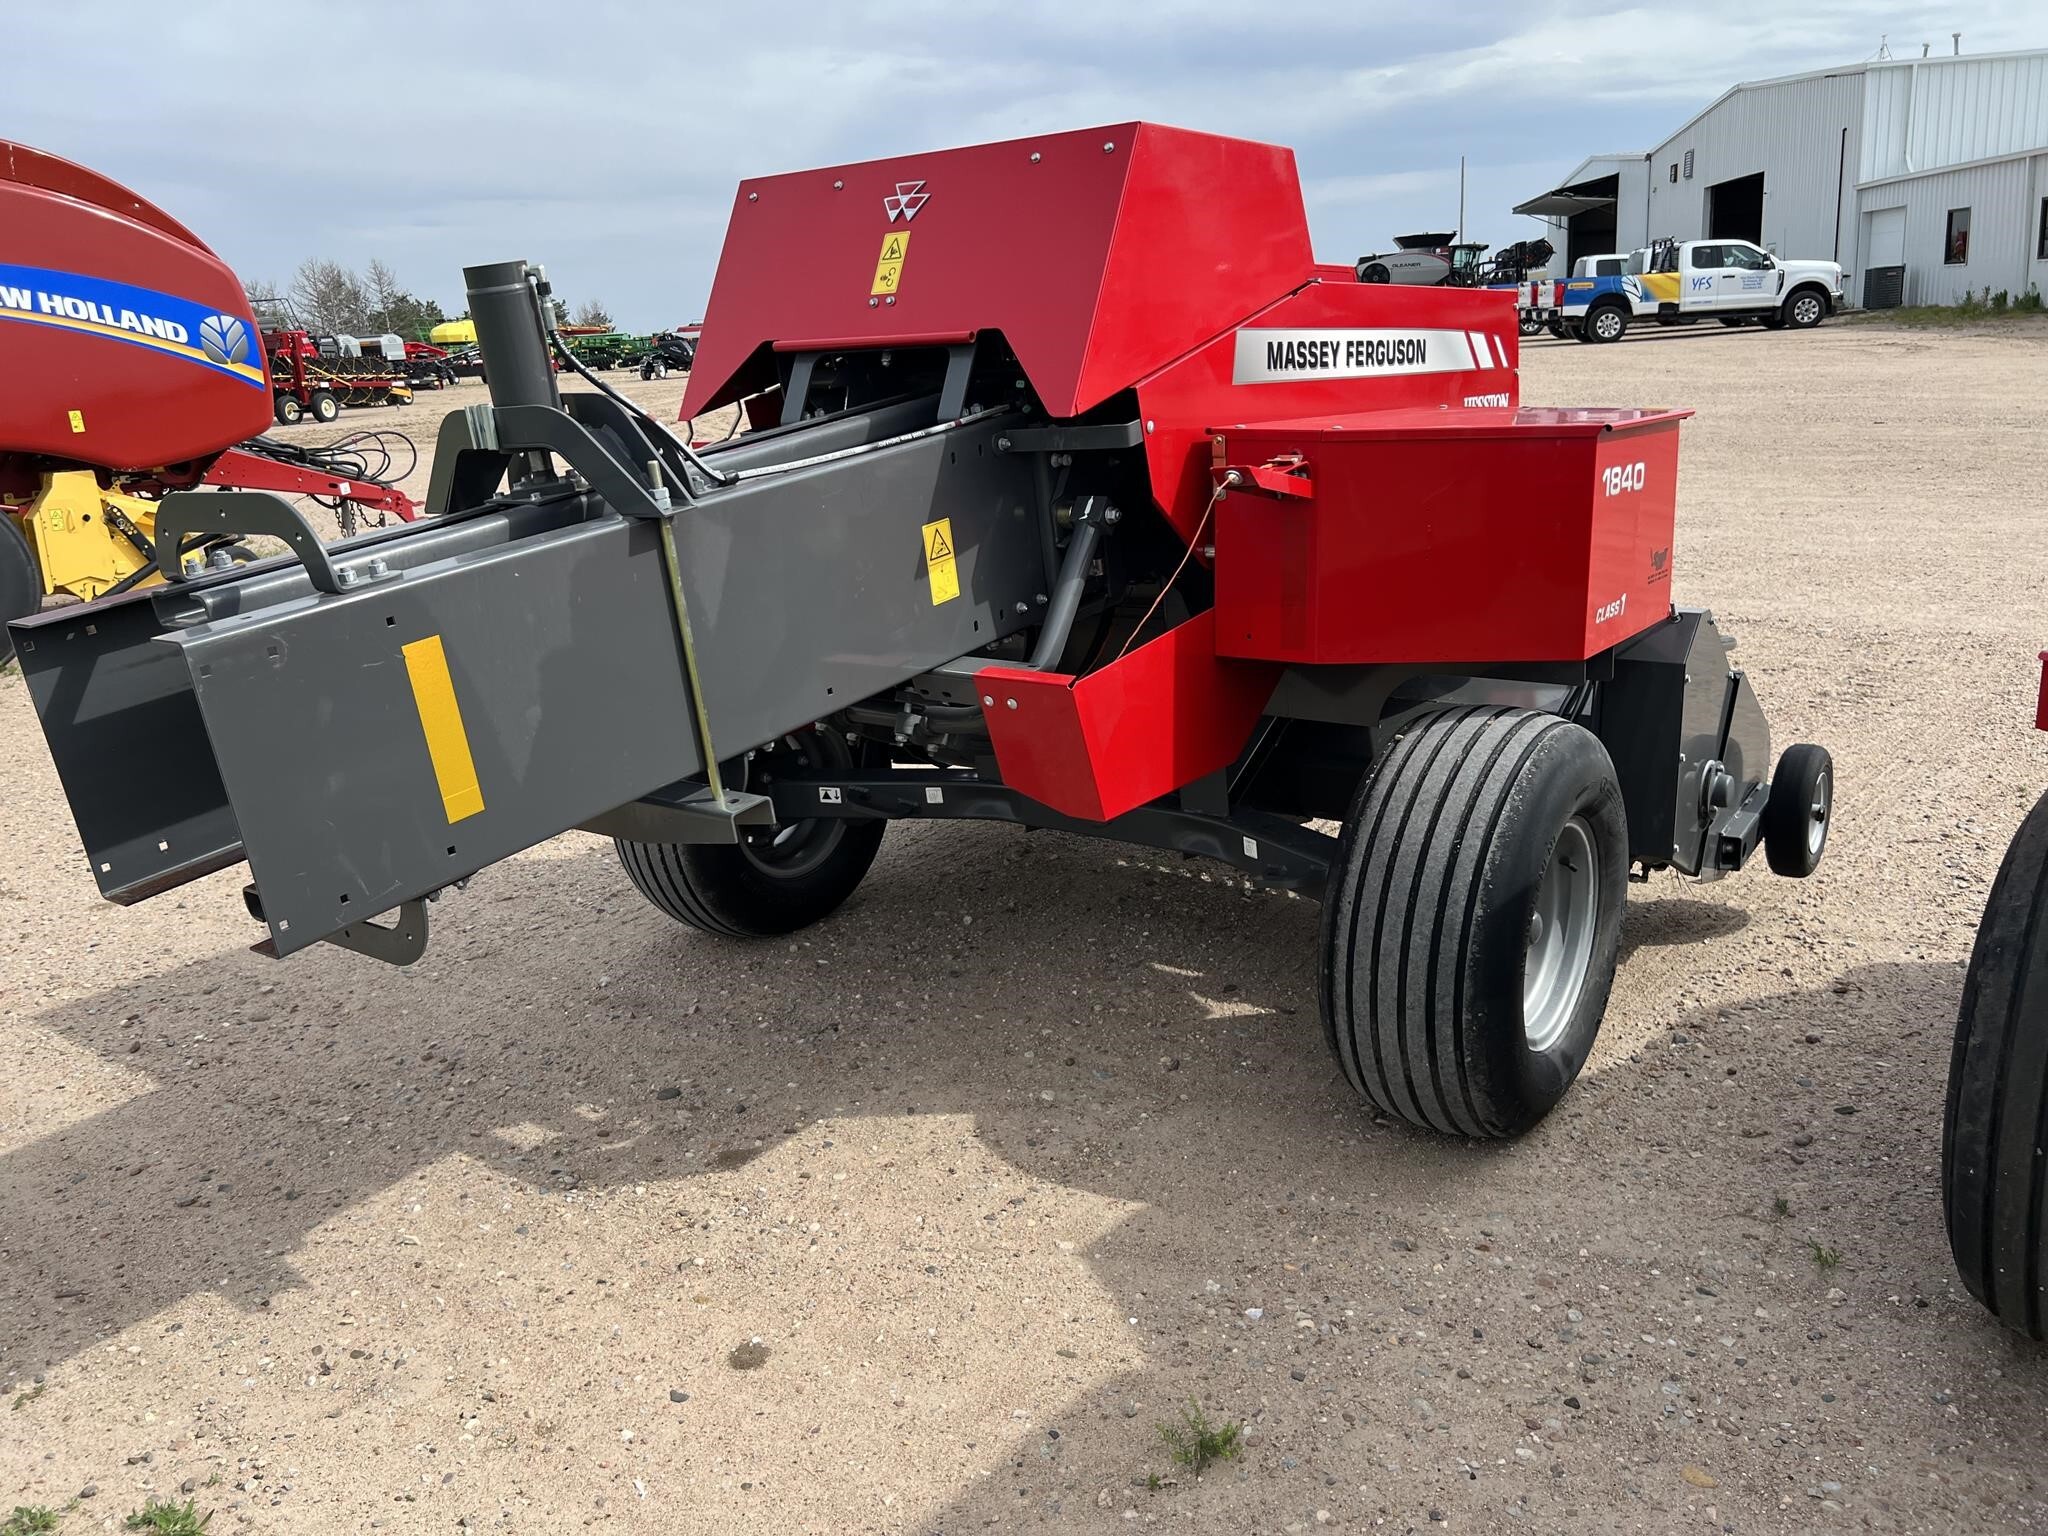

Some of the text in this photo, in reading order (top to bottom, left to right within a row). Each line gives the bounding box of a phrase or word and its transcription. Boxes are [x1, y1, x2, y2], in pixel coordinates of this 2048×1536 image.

[1692, 276, 1713, 291] YFS
[0, 286, 188, 344] W HOLLAND
[1267, 339, 1426, 370] MASSEY FERGUSON
[1602, 462, 1645, 497] 1840
[1596, 601, 1620, 624] CLASS
